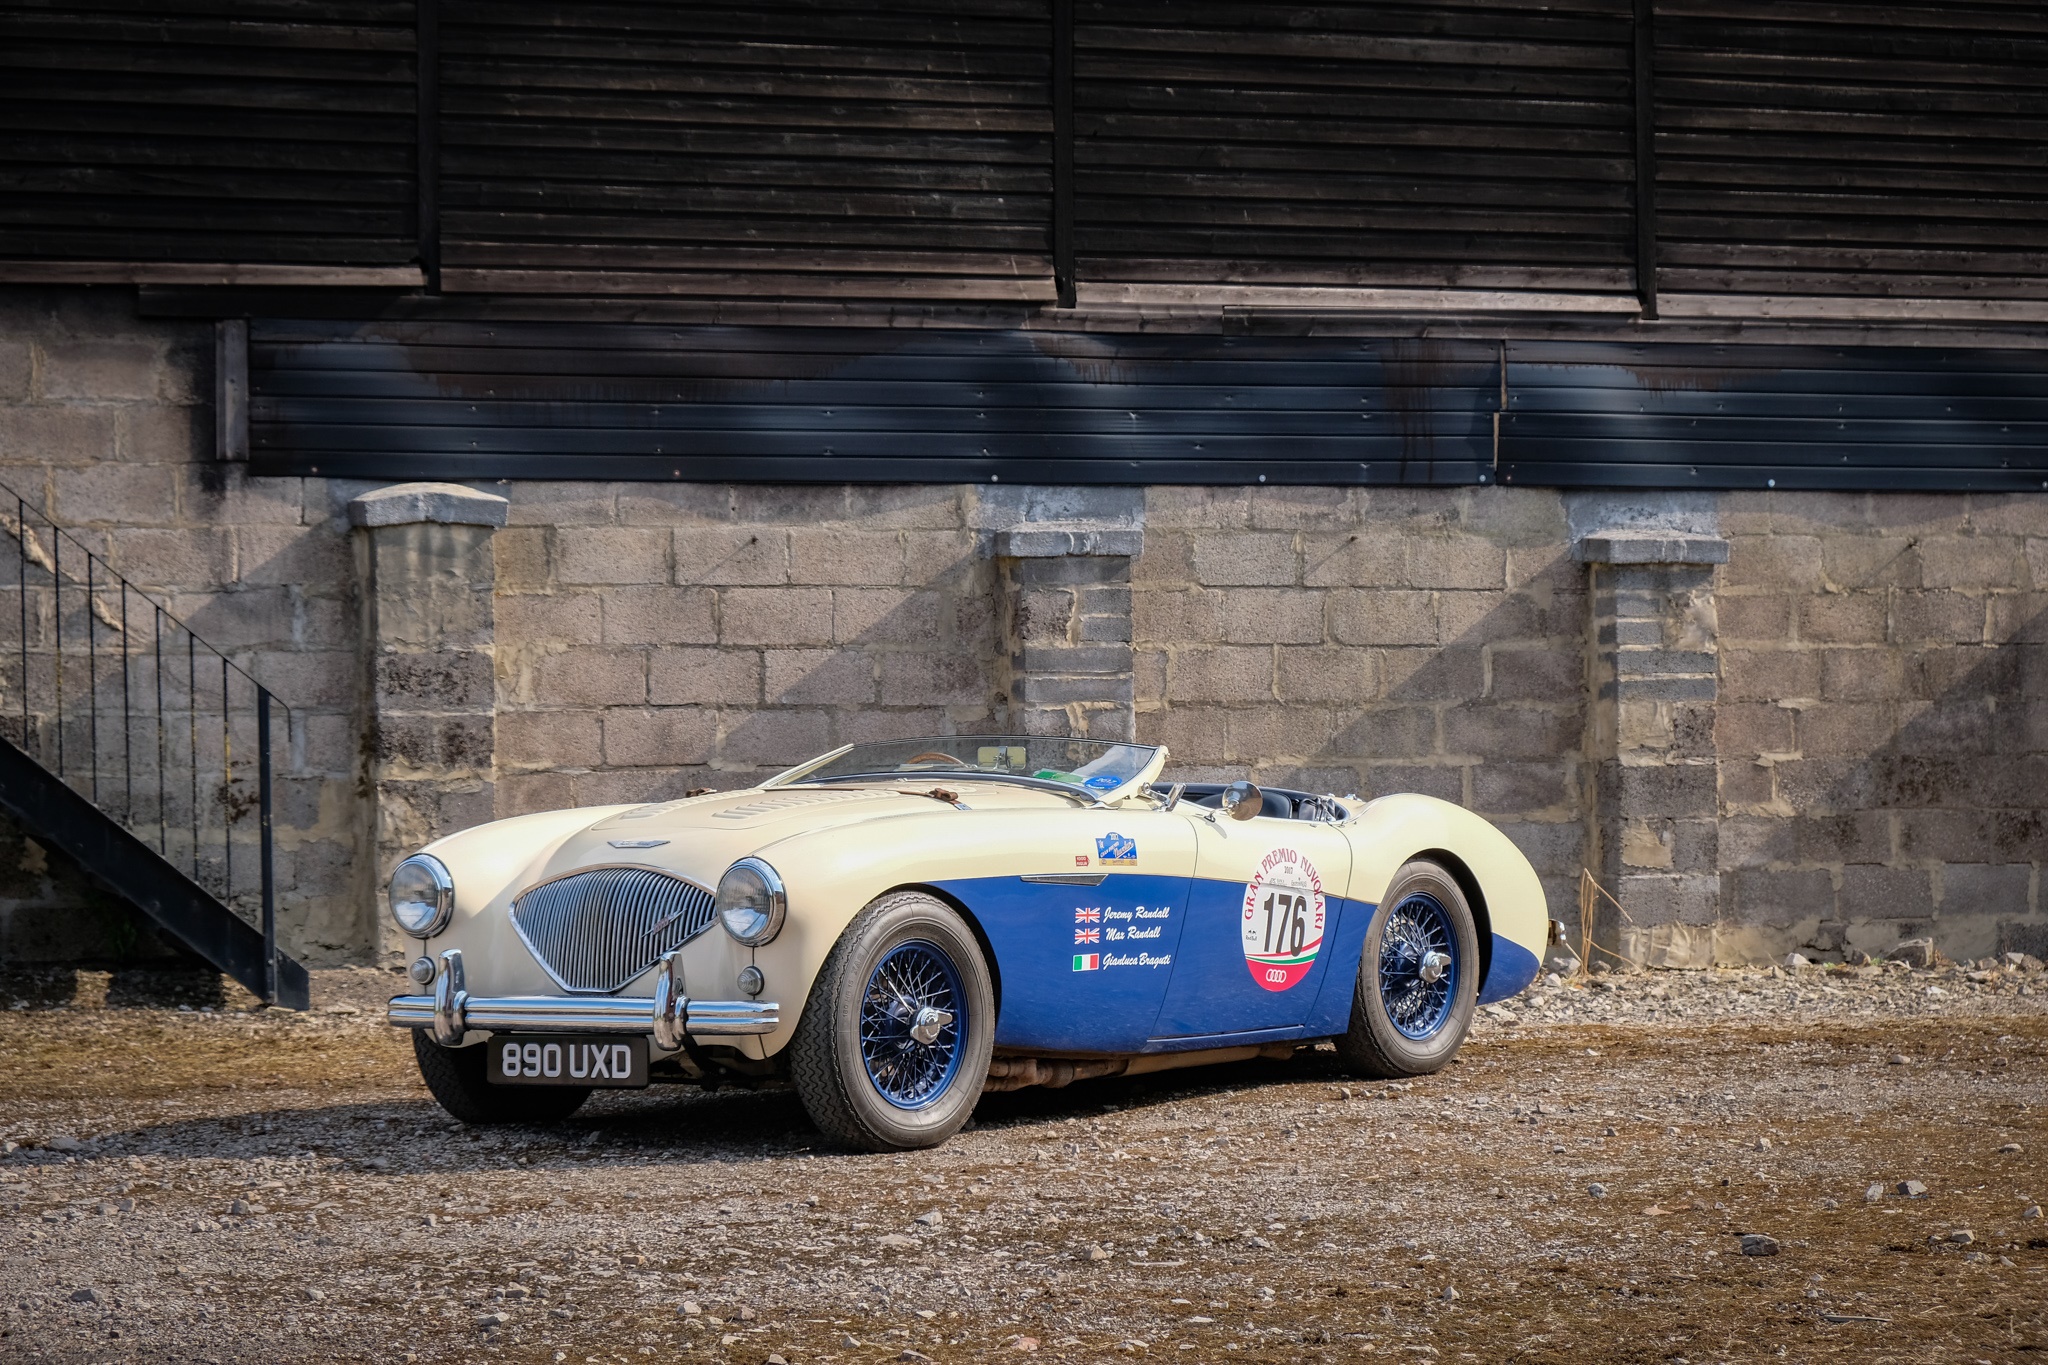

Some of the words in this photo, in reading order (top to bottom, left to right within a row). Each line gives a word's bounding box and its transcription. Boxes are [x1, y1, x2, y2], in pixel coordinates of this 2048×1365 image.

[1244, 870, 1264, 920] GRAN
[1261, 848, 1297, 874] PREMIO
[1300, 856, 1324, 930] NUVOLARI
[1103, 906, 1133, 923] Jeremy
[1135, 906, 1170, 919] Randall
[1263, 892, 1307, 957] 176
[1105, 927, 1125, 941] Max
[1127, 925, 1161, 939] Randall
[1102, 952, 1138, 970] Gianluca
[502, 1043, 561, 1078] 890
[569, 1044, 631, 1079] UXD
